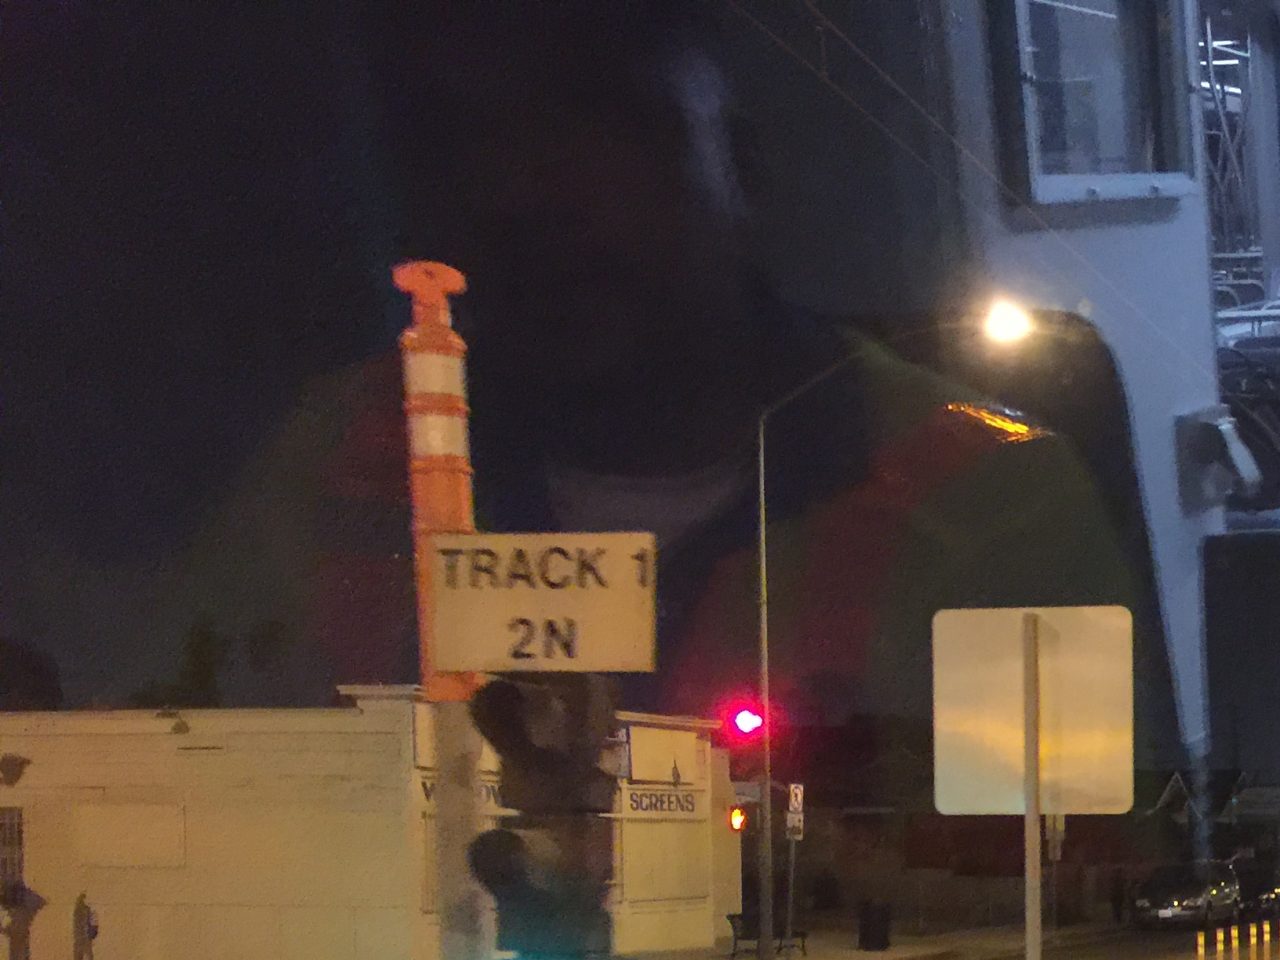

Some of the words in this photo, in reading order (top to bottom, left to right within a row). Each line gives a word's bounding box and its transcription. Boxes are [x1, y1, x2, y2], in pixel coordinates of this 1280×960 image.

[438, 546, 609, 590] TRACK
[631, 546, 651, 589] 1
[508, 616, 579, 660] 2N
[629, 791, 696, 813] SCREENS
